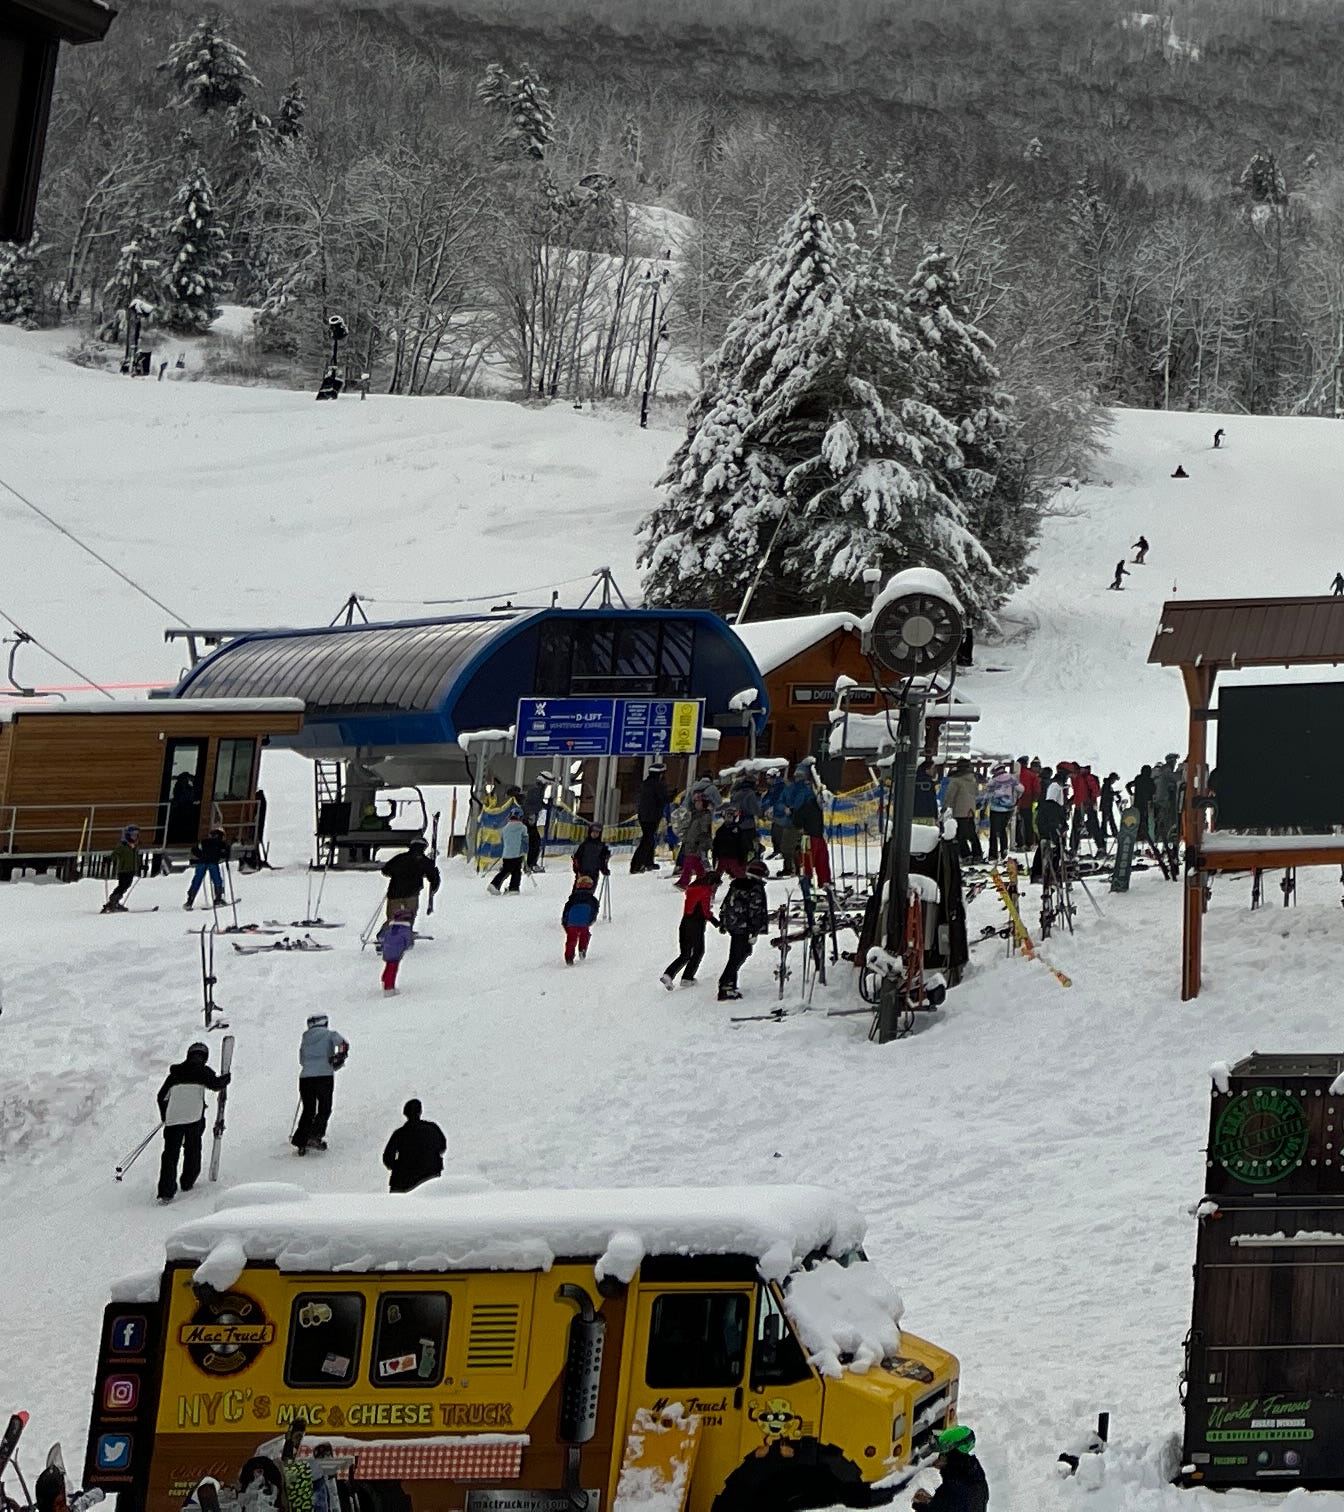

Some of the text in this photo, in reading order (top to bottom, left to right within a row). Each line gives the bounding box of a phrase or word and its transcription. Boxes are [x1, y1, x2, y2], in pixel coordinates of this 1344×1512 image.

[575, 713, 603, 721] D-LIFT
[187, 1327, 268, 1343] Mac Truck
[177, 1388, 271, 1427] NYC's
[276, 1404, 322, 1426] MAC
[348, 1402, 433, 1425] CHEESE
[439, 1402, 514, 1425] TRUCK
[686, 1397, 728, 1412] Truck
[1208, 1394, 1312, 1428] World Famous
